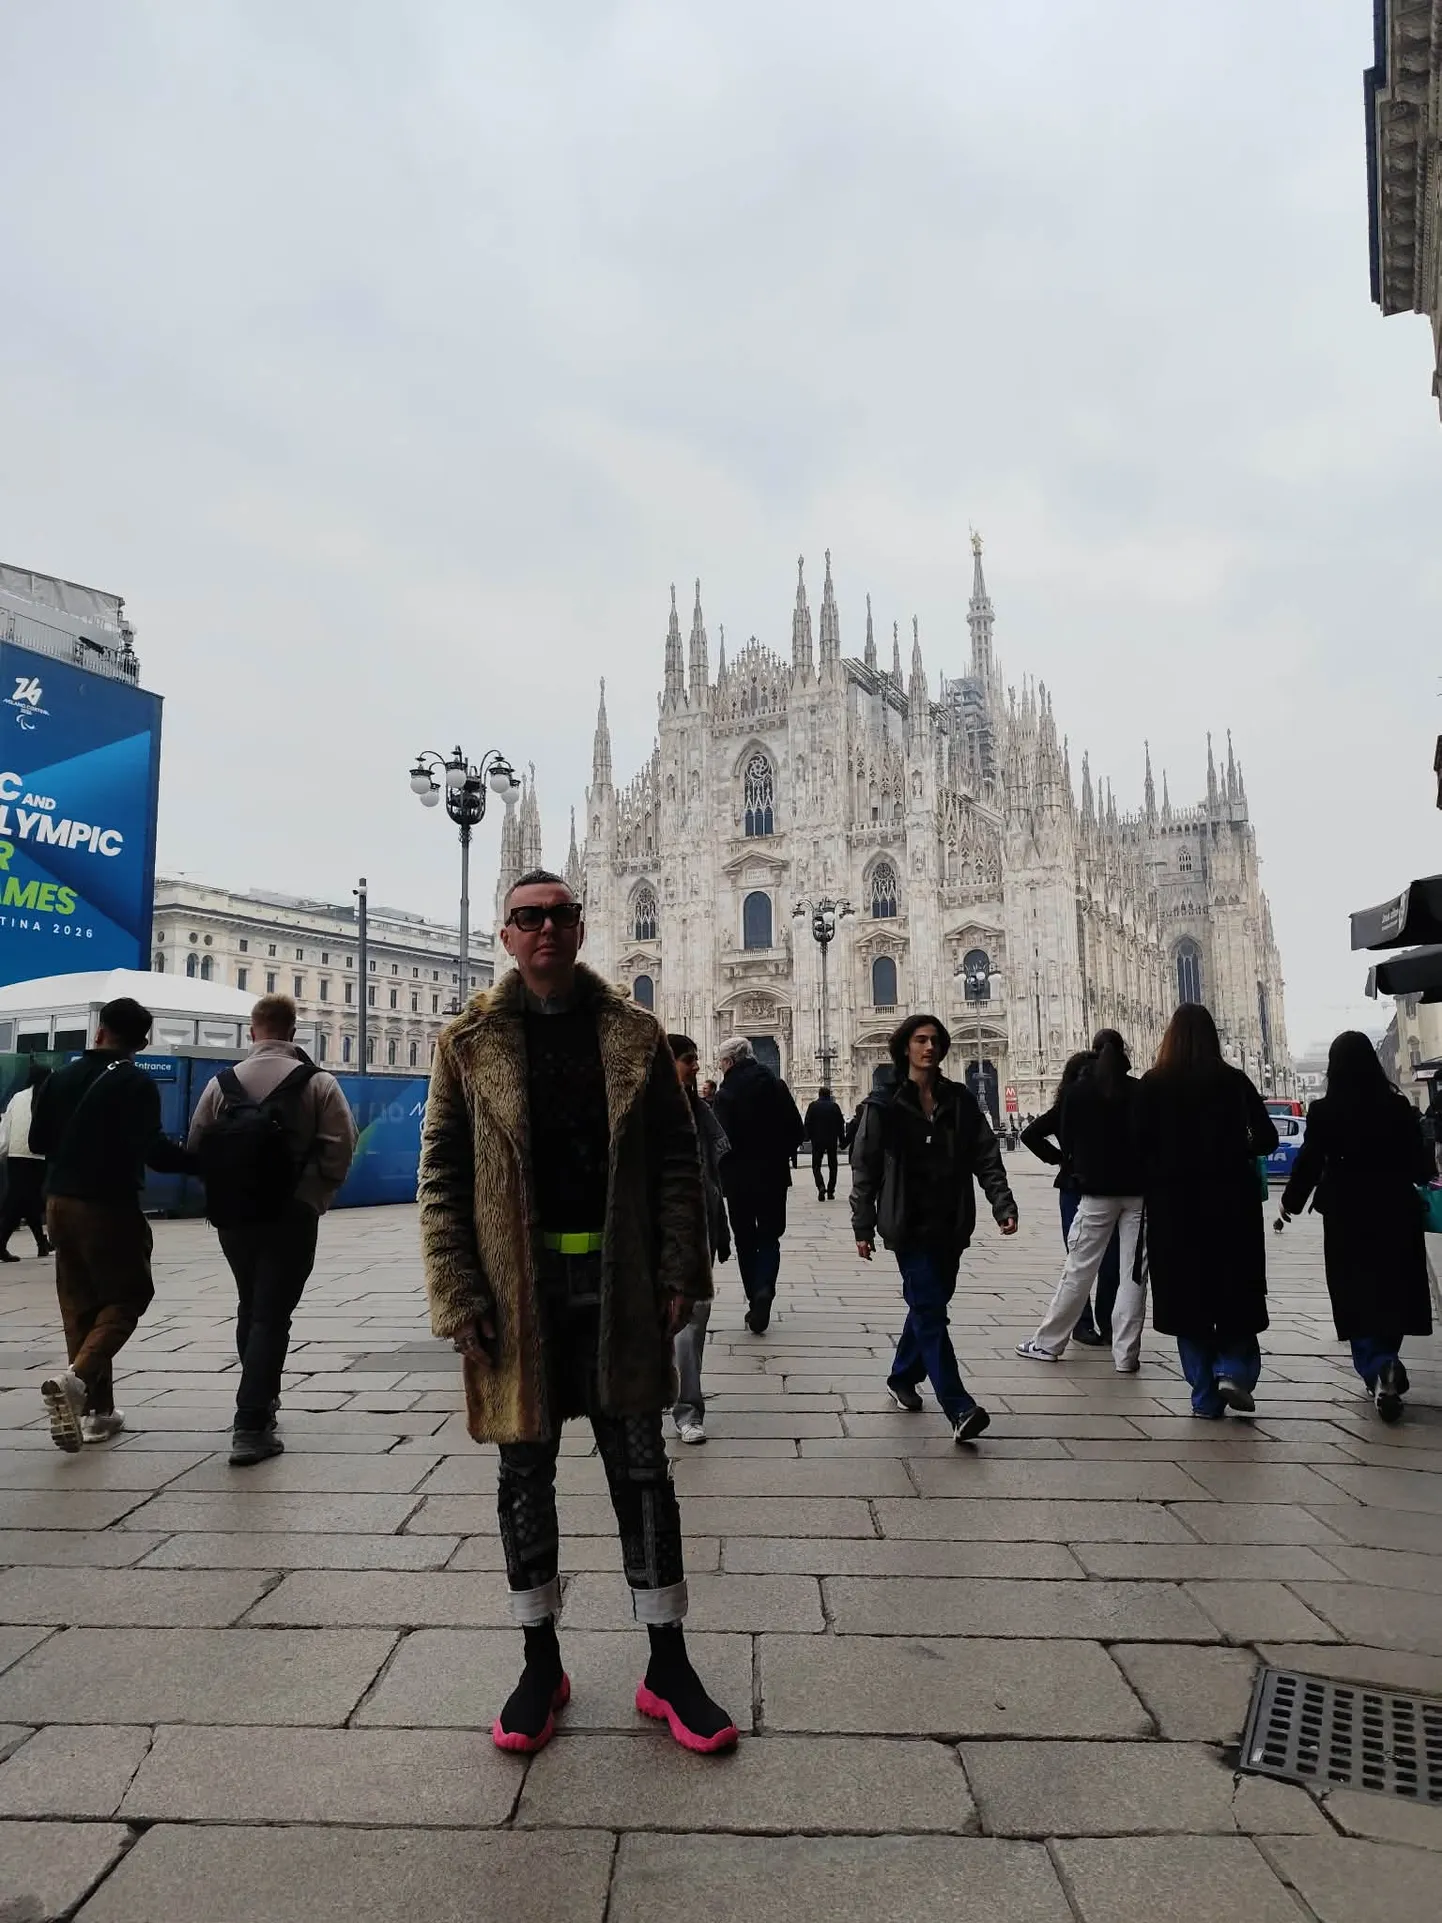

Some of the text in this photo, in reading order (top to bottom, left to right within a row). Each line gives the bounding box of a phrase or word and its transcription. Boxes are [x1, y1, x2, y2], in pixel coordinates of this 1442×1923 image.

[21, 793, 56, 811] AND
[0, 876, 78, 916] MES
[53, 923, 93, 940] 2026
